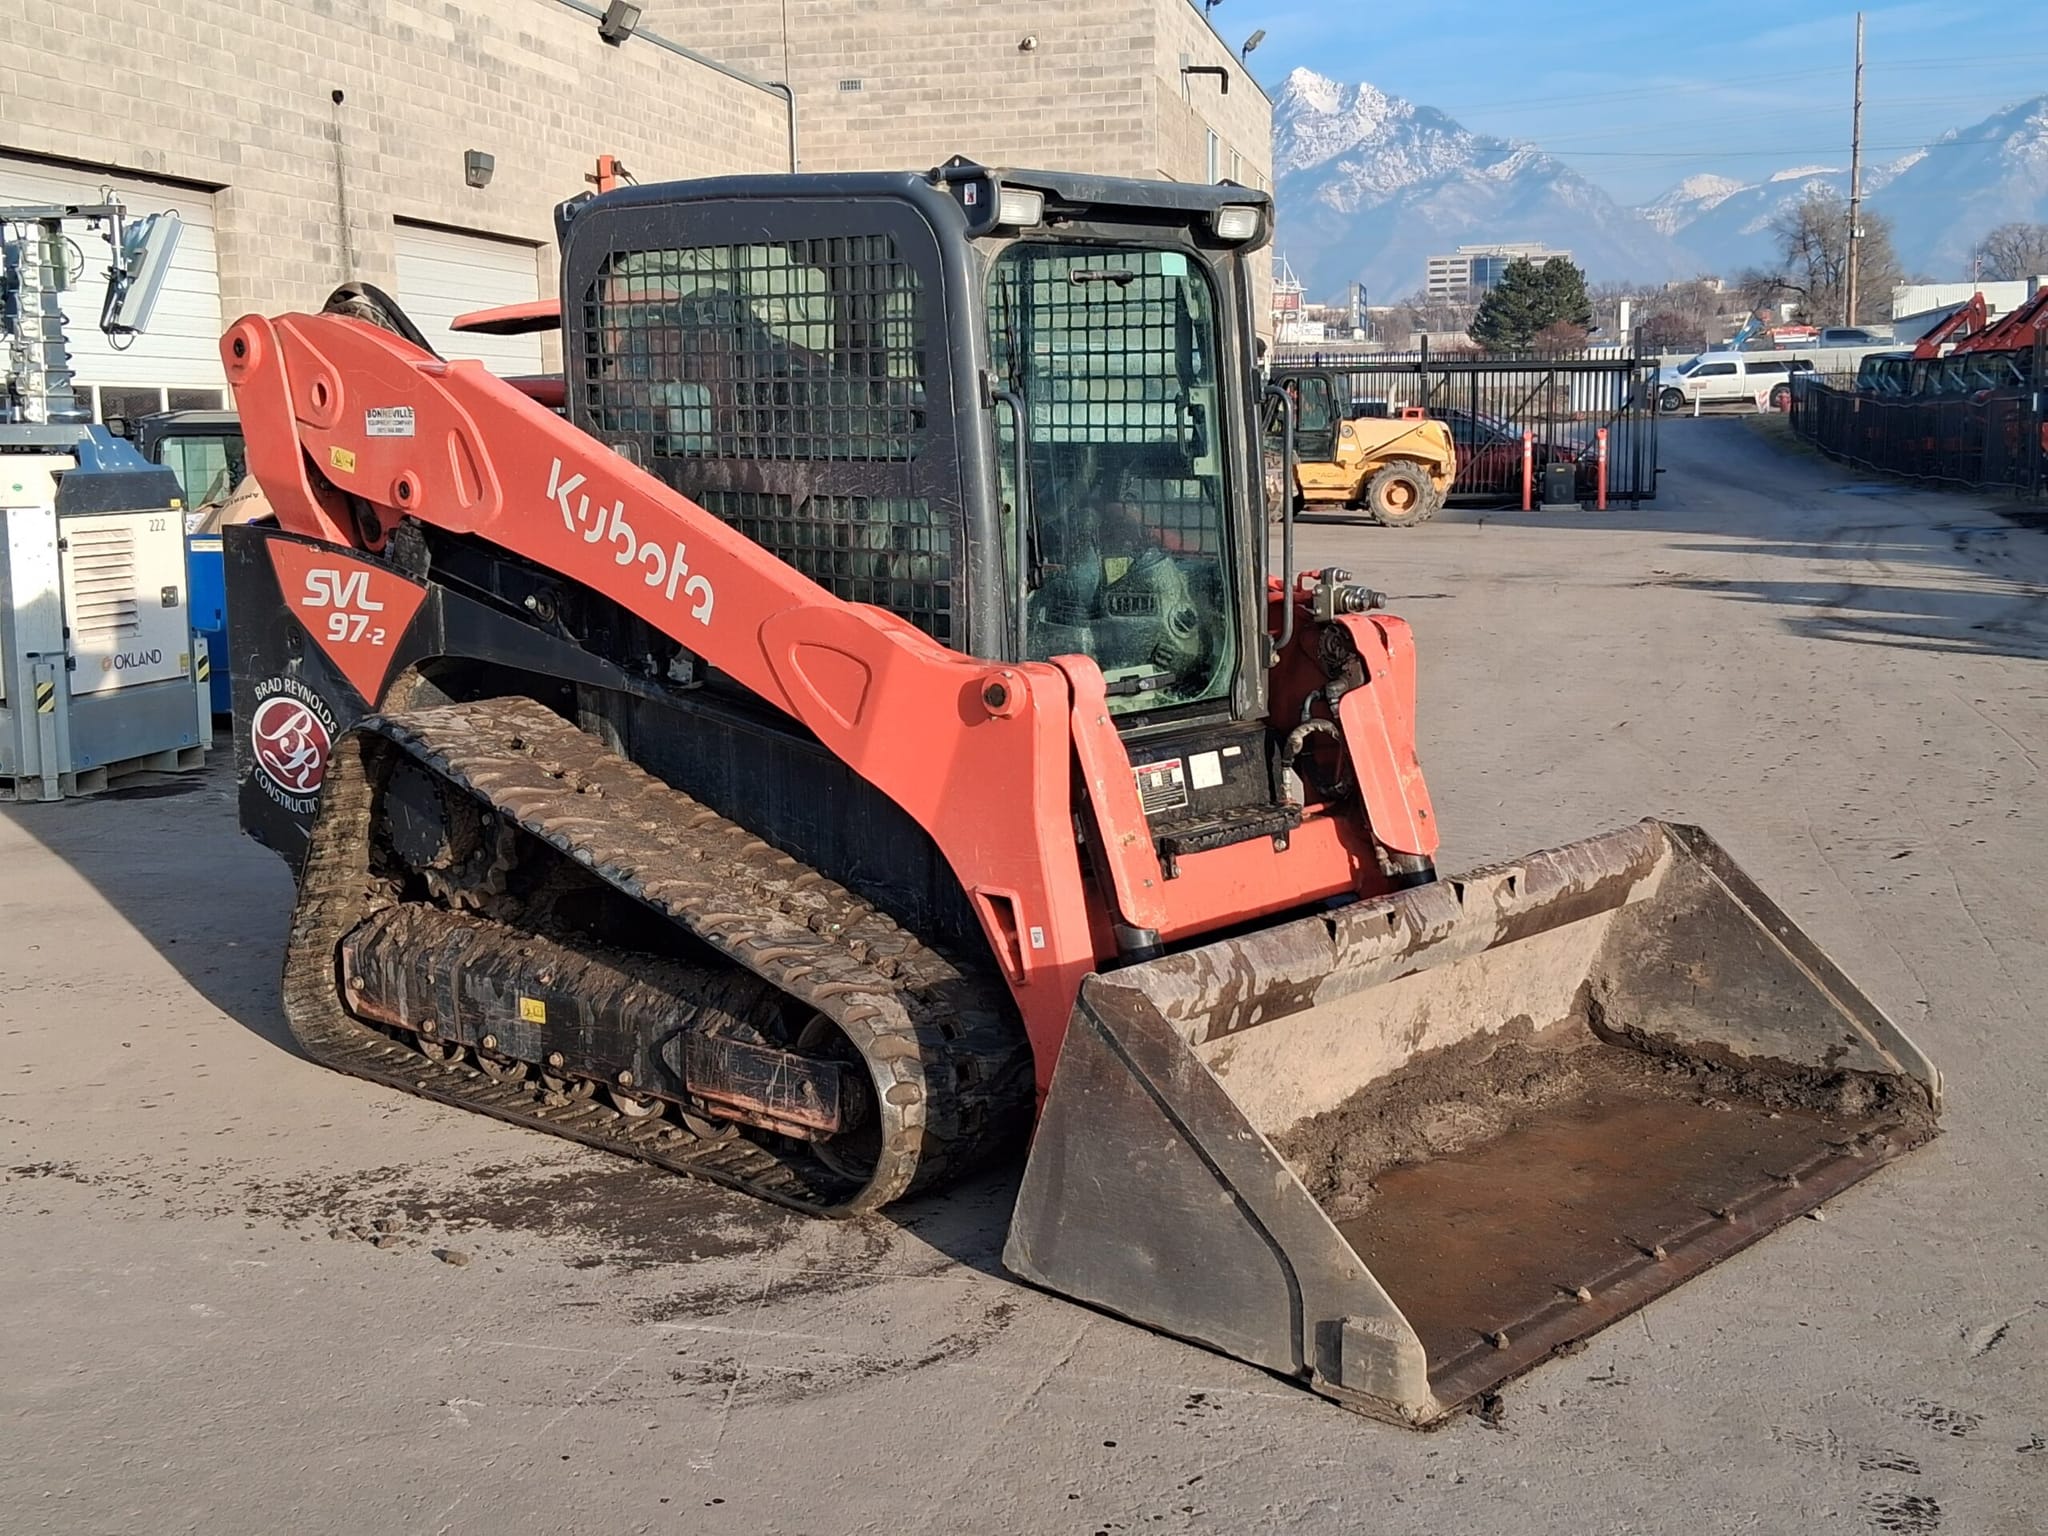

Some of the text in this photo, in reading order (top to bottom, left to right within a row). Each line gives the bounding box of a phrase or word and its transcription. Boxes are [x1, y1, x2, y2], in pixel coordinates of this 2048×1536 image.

[149, 518, 167, 532] 222
[546, 457, 714, 626] Kubota
[302, 569, 384, 611] SVL
[114, 649, 162, 670] OKLAND
[254, 677, 338, 734] BRAD REYNOLDS
